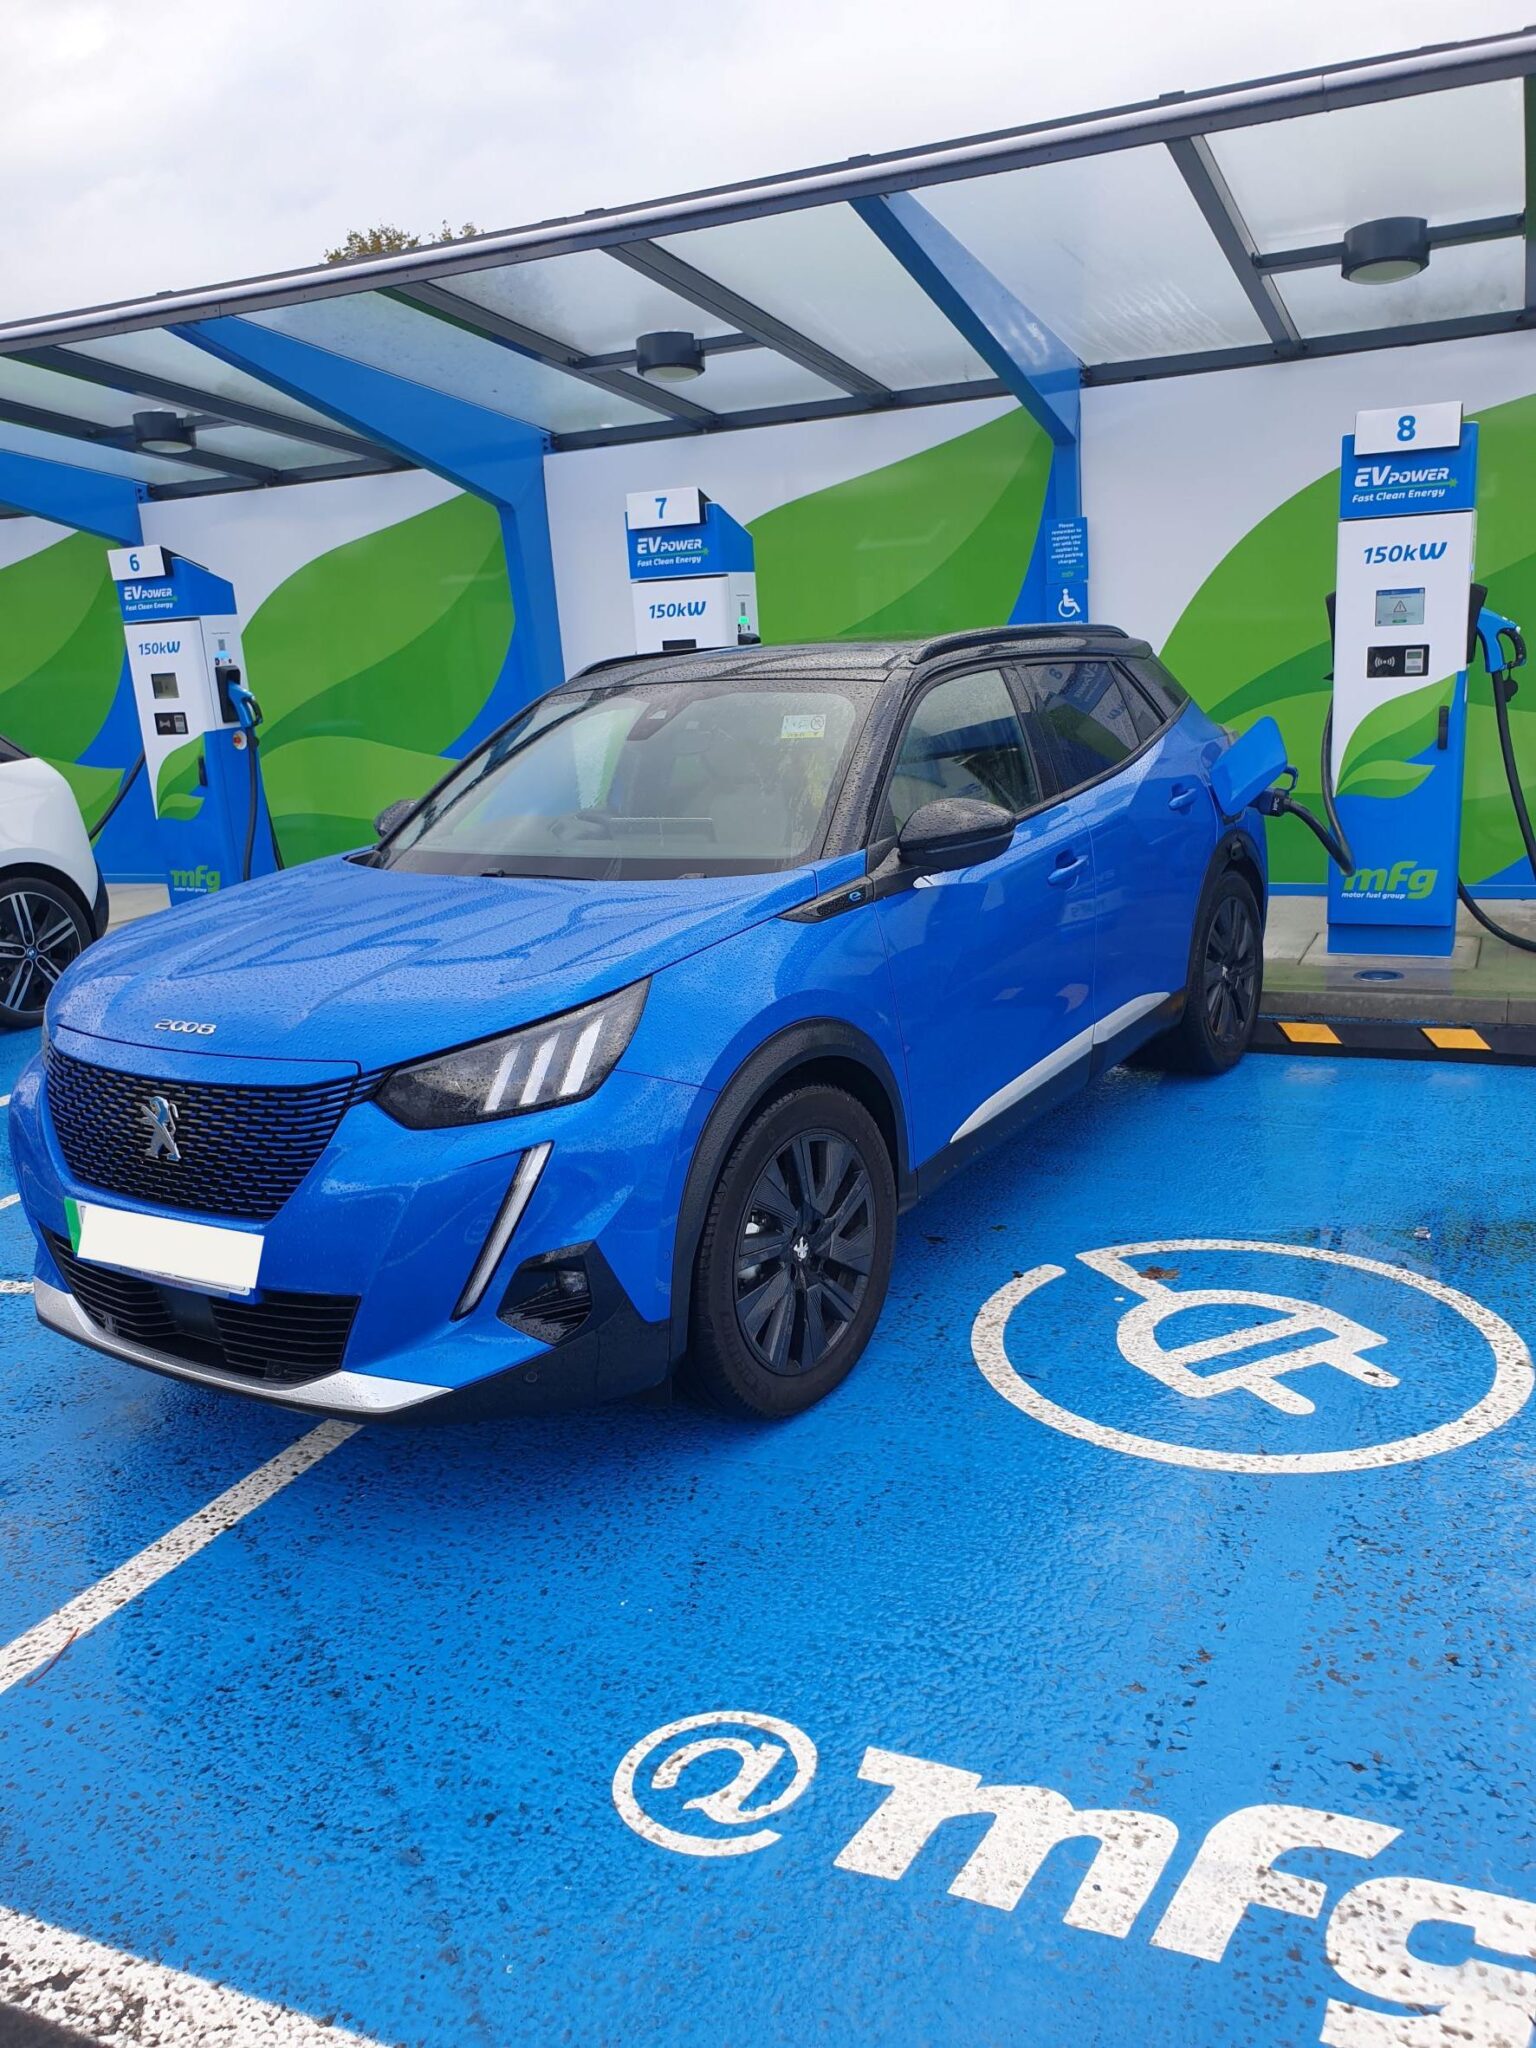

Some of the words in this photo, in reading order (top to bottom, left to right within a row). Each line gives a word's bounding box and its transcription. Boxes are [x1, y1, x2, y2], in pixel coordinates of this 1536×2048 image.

[1397, 415, 1416, 442] 8
[1352, 493, 1374, 503] Fast
[1376, 491, 1406, 501] Clean
[1408, 488, 1446, 499] Energy
[655, 497, 667, 519] 7
[637, 559, 652, 567] Fast
[654, 558, 674, 566] Clean
[675, 556, 702, 565] Energy
[1364, 541, 1448, 565] 150kW
[129, 554, 140, 572] 6
[649, 601, 707, 619] 150kW
[138, 640, 181, 656] 150kW
[154, 1018, 217, 1035] 2008
